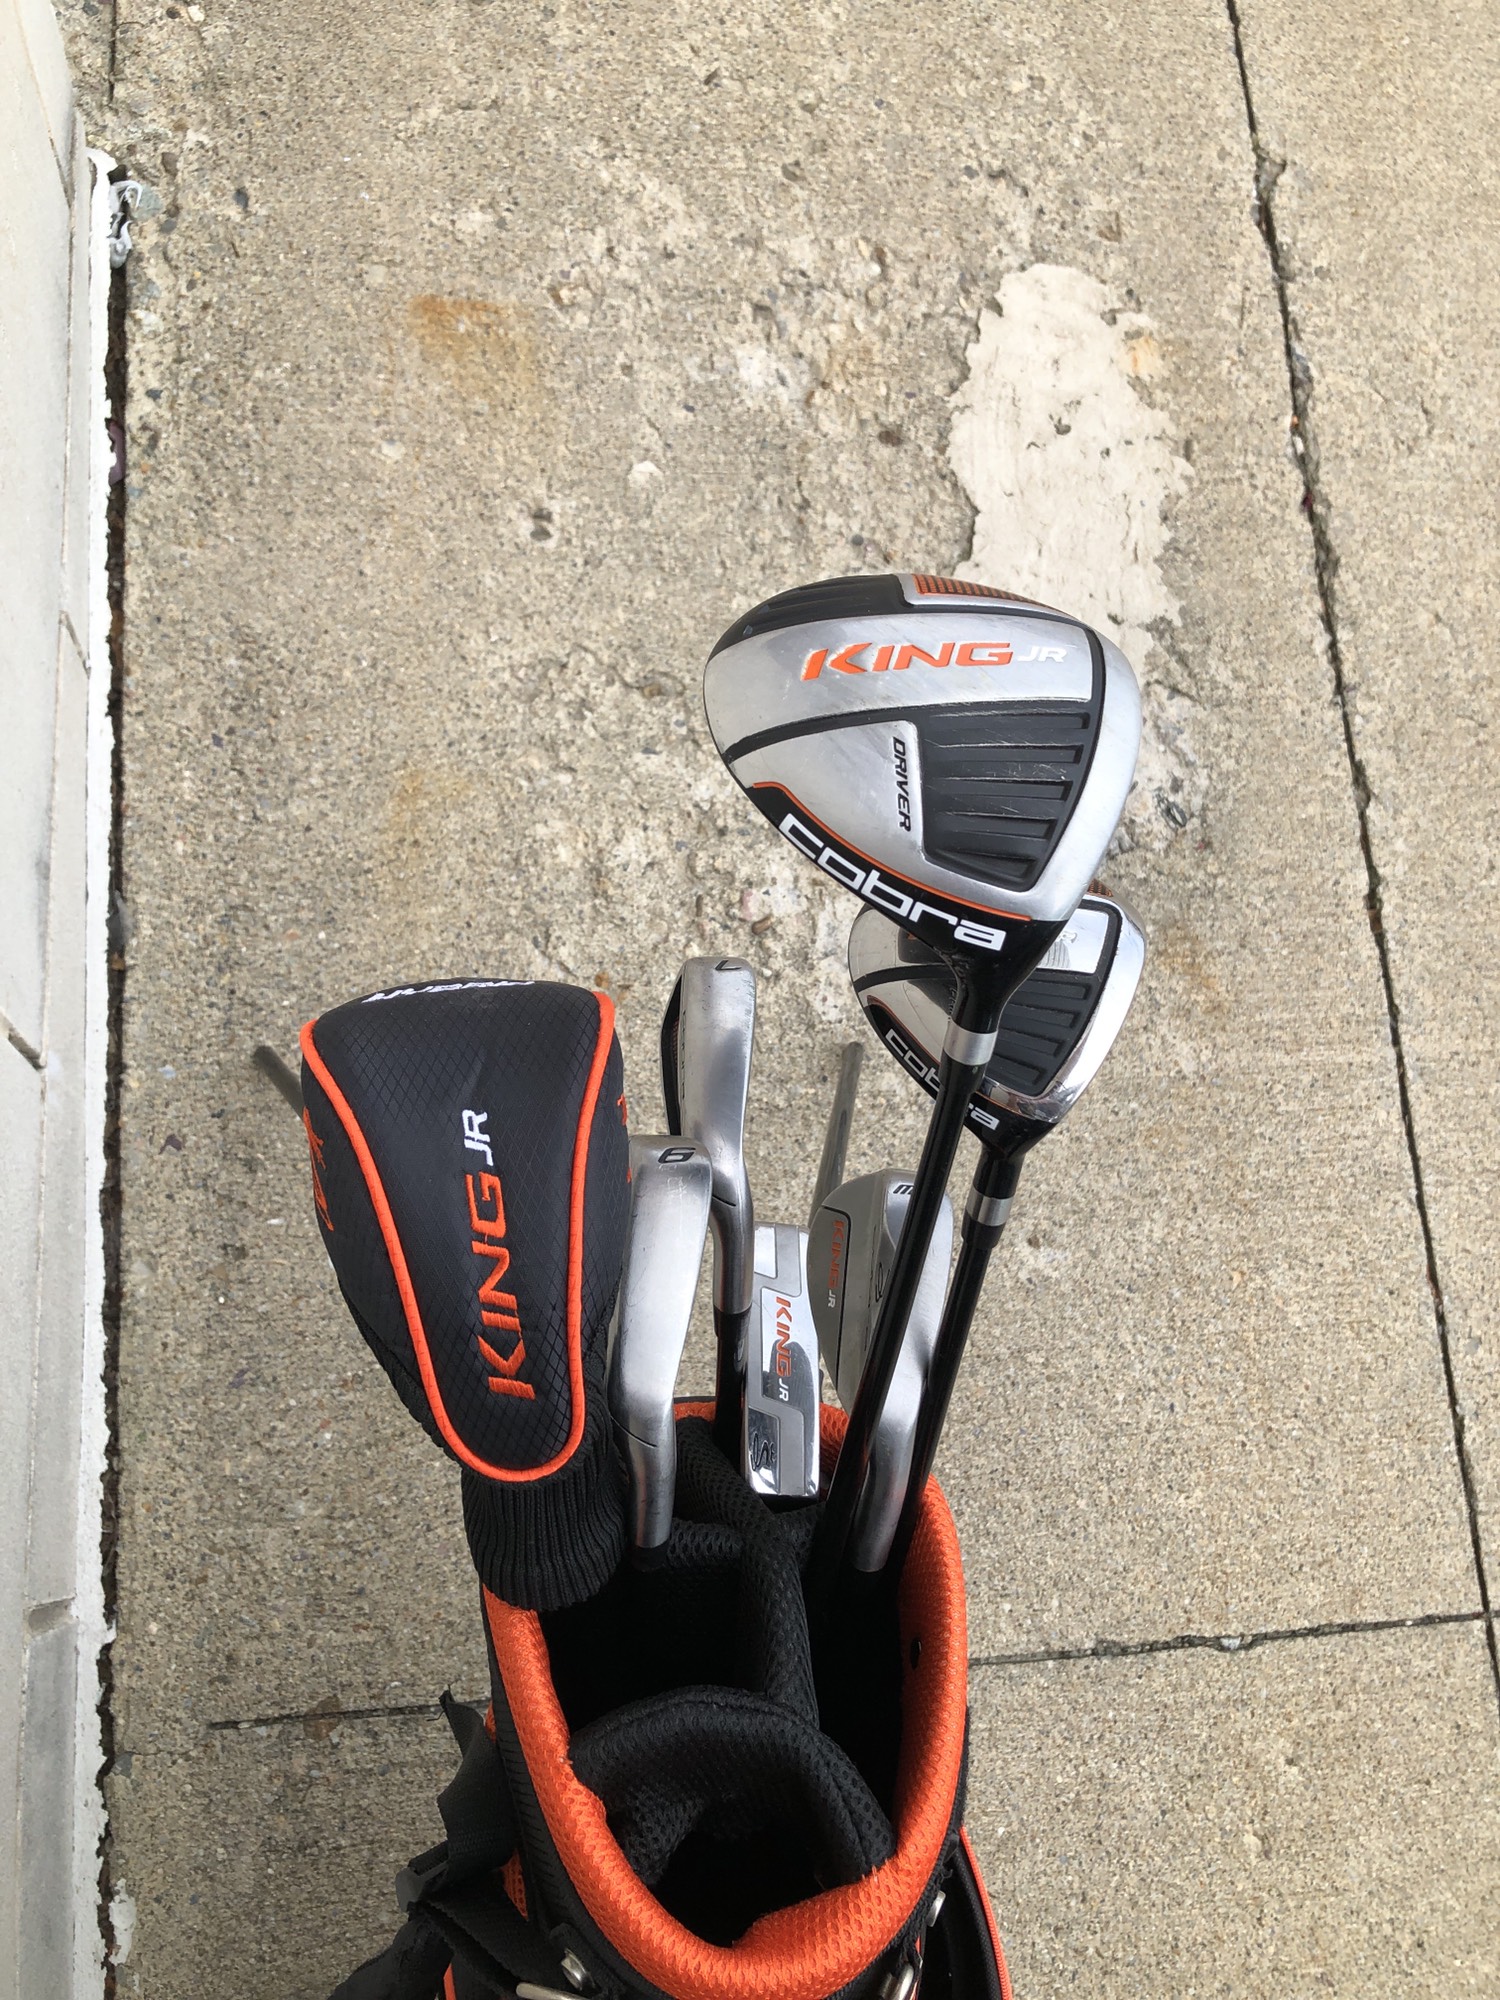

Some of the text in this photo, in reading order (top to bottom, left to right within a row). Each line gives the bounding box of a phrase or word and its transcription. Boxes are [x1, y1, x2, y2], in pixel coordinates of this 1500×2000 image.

[801, 641, 1068, 681] KING JR
[892, 736, 912, 832] DRIVER
[778, 812, 1007, 952] cobra
[885, 1028, 1000, 1131] coba
[461, 1108, 536, 1400] KING JR
[827, 1220, 846, 1308] KING JR
[775, 1296, 793, 1402] KING JR
